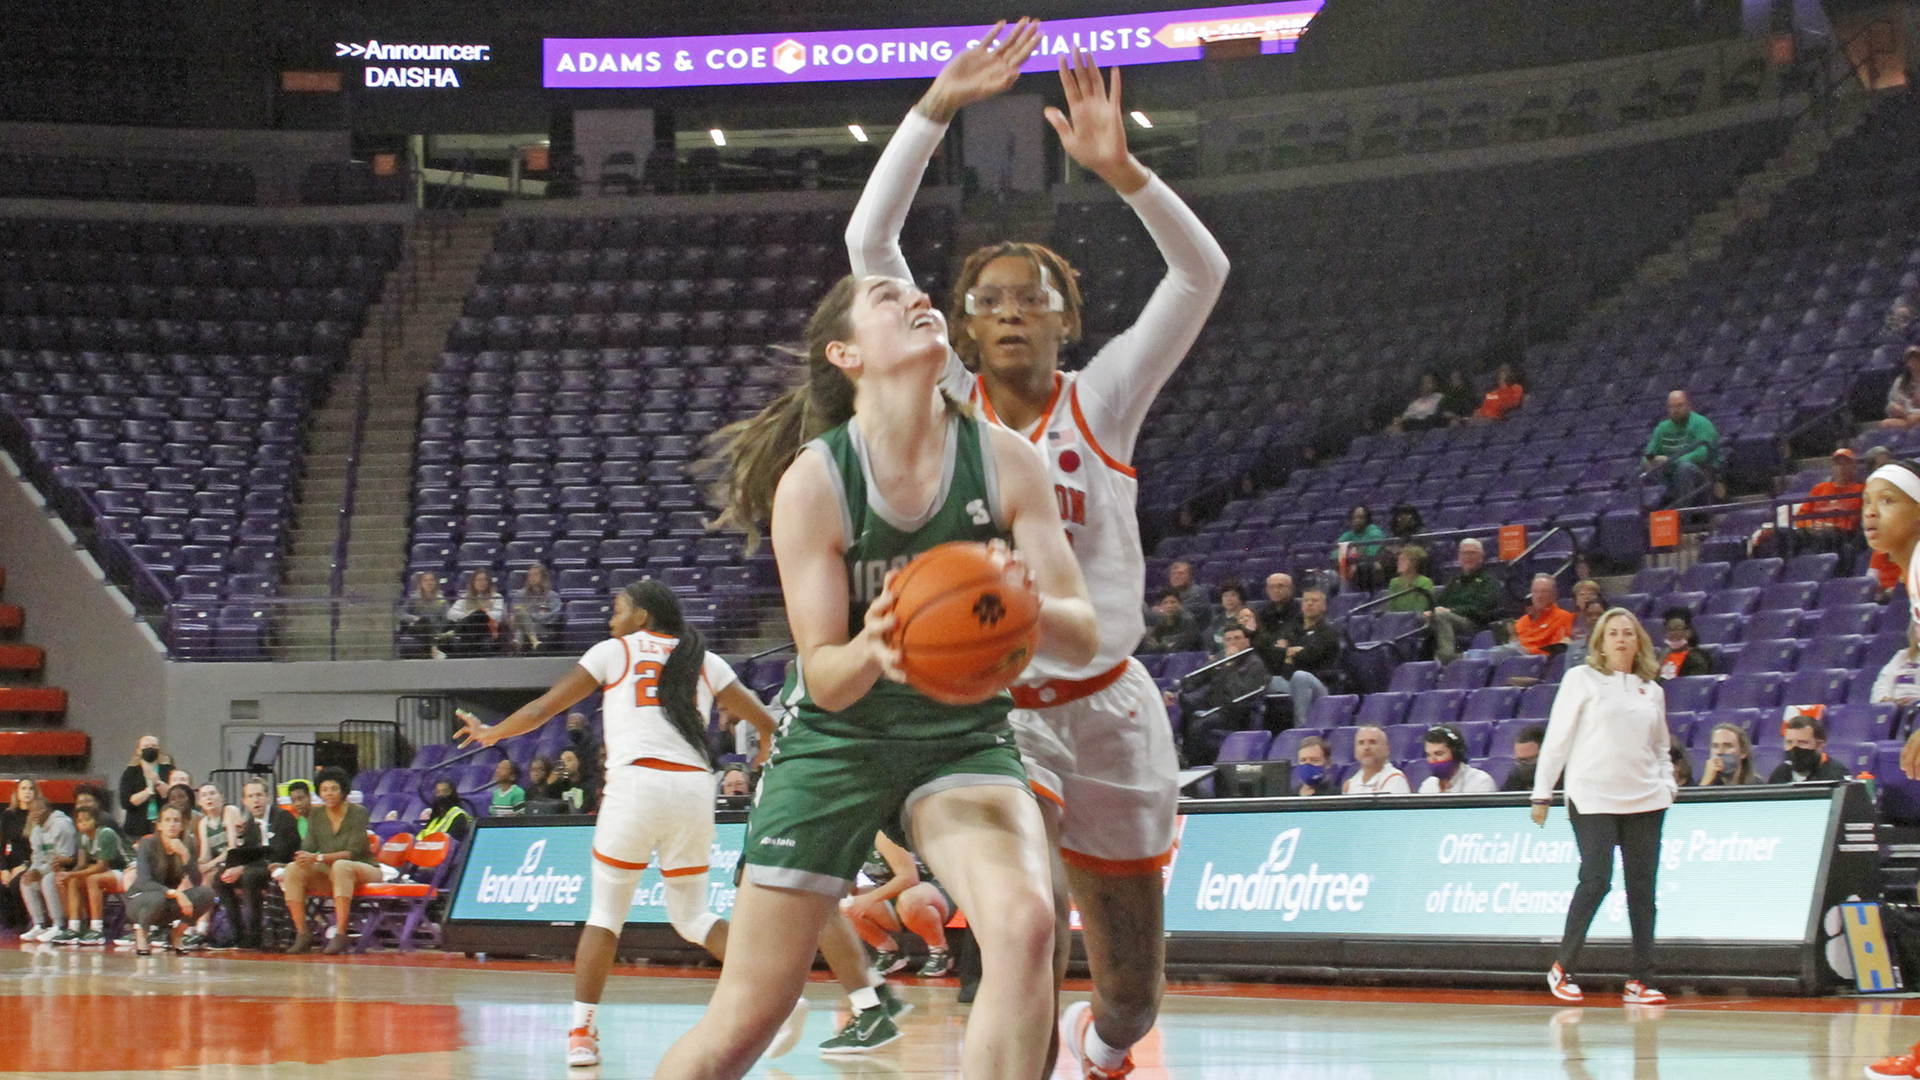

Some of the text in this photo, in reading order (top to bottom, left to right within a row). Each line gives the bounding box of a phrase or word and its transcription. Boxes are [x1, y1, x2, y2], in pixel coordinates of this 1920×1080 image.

[556, 51, 662, 72] ADAMS
[674, 50, 694, 71] &
[706, 47, 767, 69] COE
[812, 40, 953, 66] ROOFING
[365, 67, 460, 87] DAISHA
[635, 660, 664, 707] 2
[1438, 833, 1520, 864] Official
[1520, 833, 1576, 863] Loan
[1686, 829, 1781, 861] Partner
[476, 865, 584, 912] lendingtree
[1196, 861, 1369, 921] lendingtree
[1426, 882, 1453, 913] of
[1452, 883, 1489, 913] the
[1492, 882, 1574, 914] Clemso
